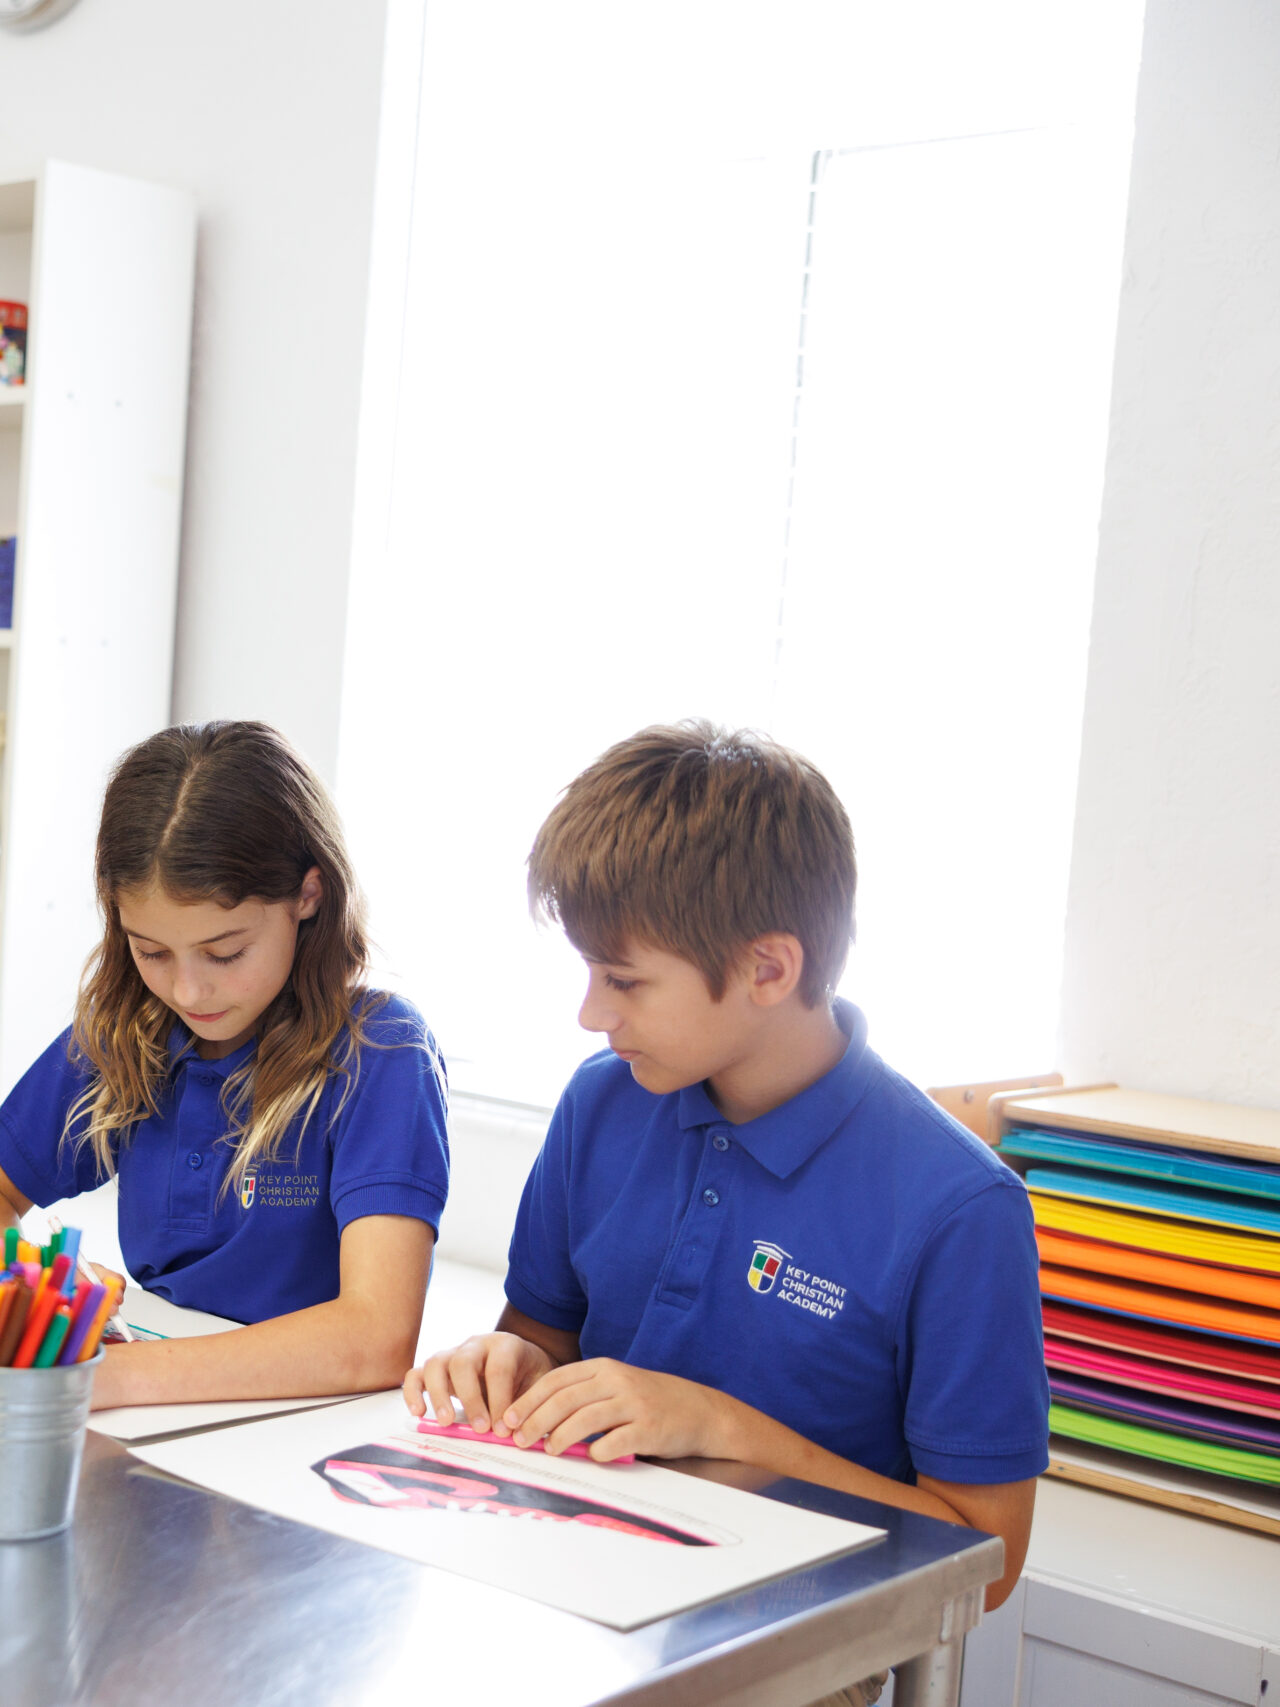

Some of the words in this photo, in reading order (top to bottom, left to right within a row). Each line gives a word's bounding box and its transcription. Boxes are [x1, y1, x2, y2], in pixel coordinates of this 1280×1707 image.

[259, 1175, 281, 1184] KEY
[285, 1175, 318, 1184] POINT
[258, 1186, 319, 1195] CHRISTIAN
[260, 1197, 317, 1206] ACADEMY
[785, 1264, 810, 1281] KEY
[811, 1276, 847, 1297] POINT
[782, 1277, 843, 1310] CHRISTIAN
[777, 1289, 836, 1319] ACADEMY
